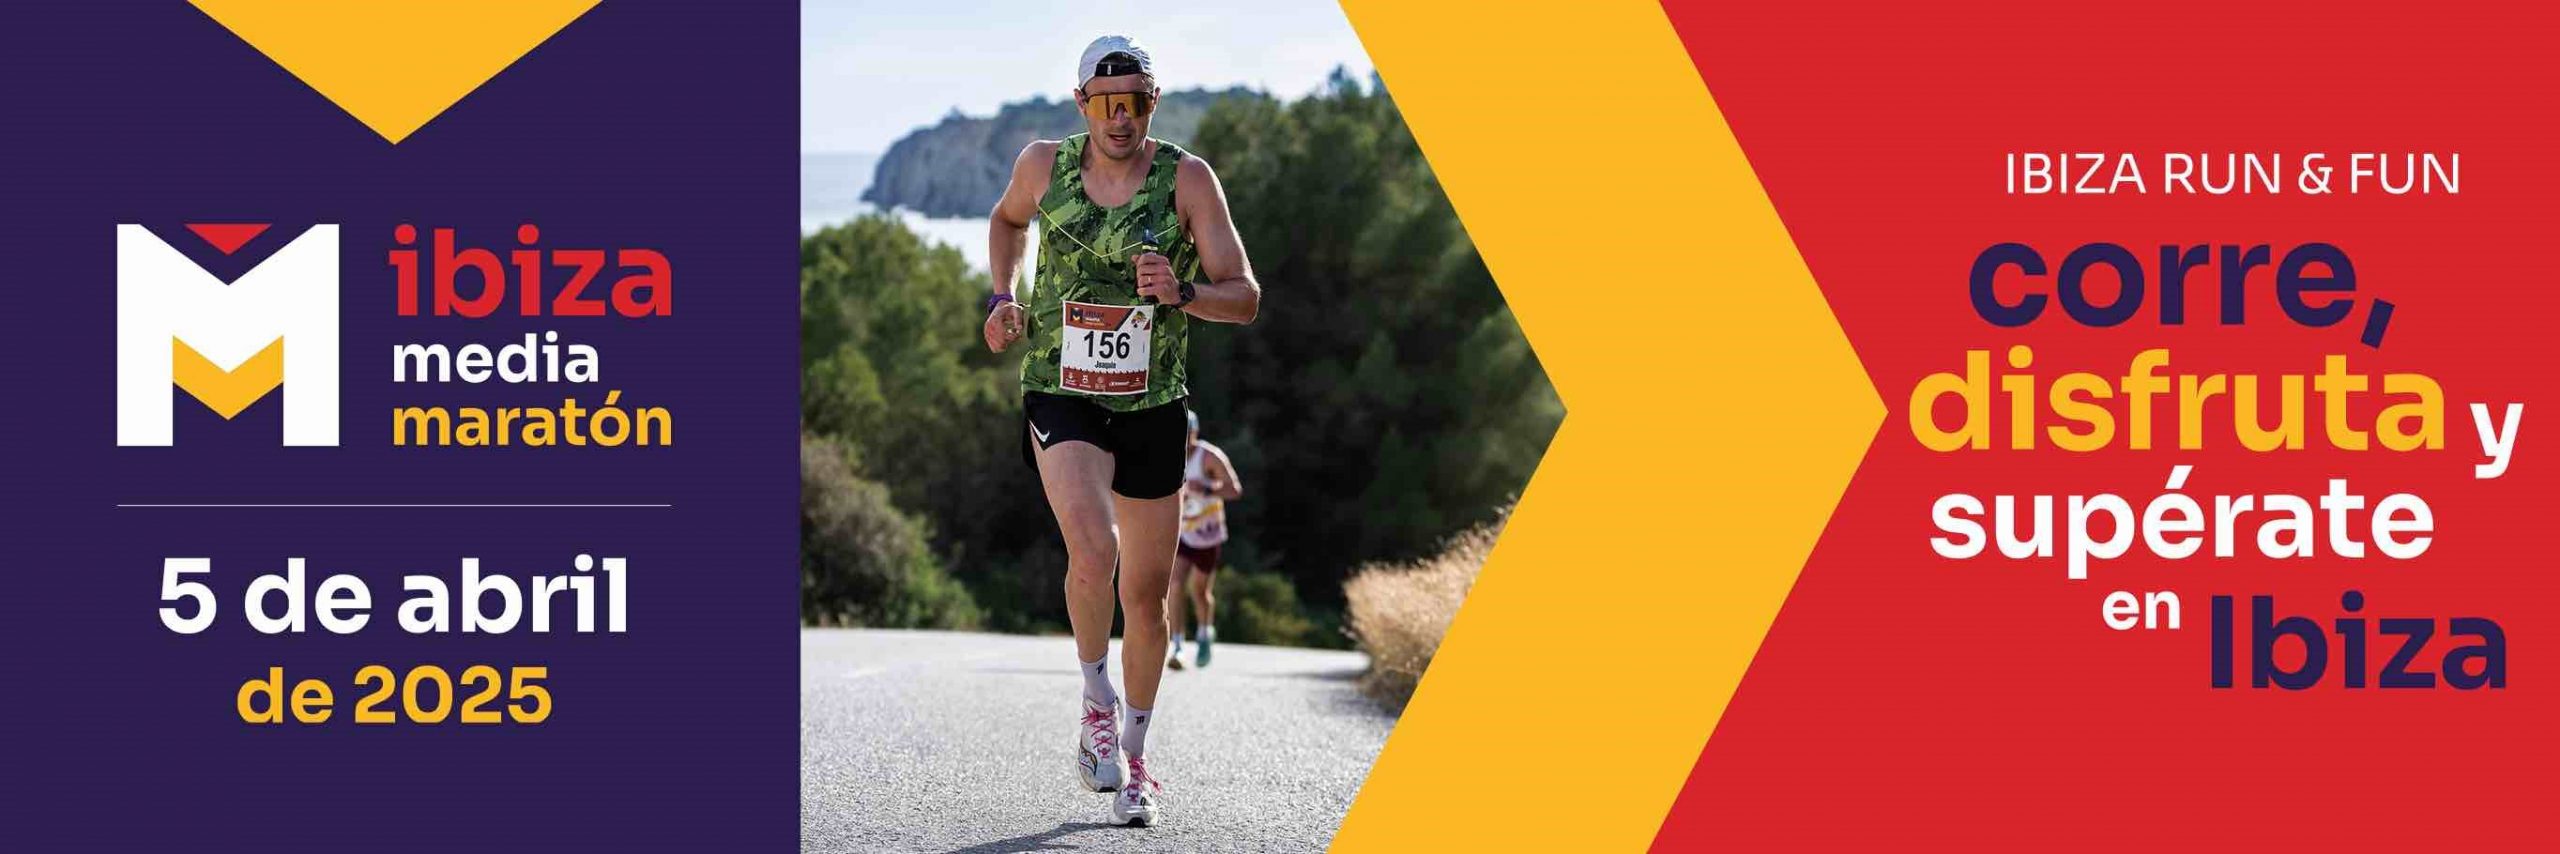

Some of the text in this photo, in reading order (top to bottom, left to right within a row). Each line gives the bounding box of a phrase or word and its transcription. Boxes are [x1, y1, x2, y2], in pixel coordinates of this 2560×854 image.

[2007, 152, 2459, 195] IBIZA RUN & FUN
[389, 224, 672, 318] ibiza
[1969, 242, 2395, 349] corre,
[394, 330, 598, 383] media
[1084, 331, 1130, 359] 156
[393, 390, 672, 447] maratón
[1910, 345, 2524, 479] disfruta y
[1930, 465, 2434, 580] supérate
[159, 554, 626, 634] 5 de abril
[2102, 590, 2506, 691] en Ibiza
[237, 665, 552, 724] de 2025
